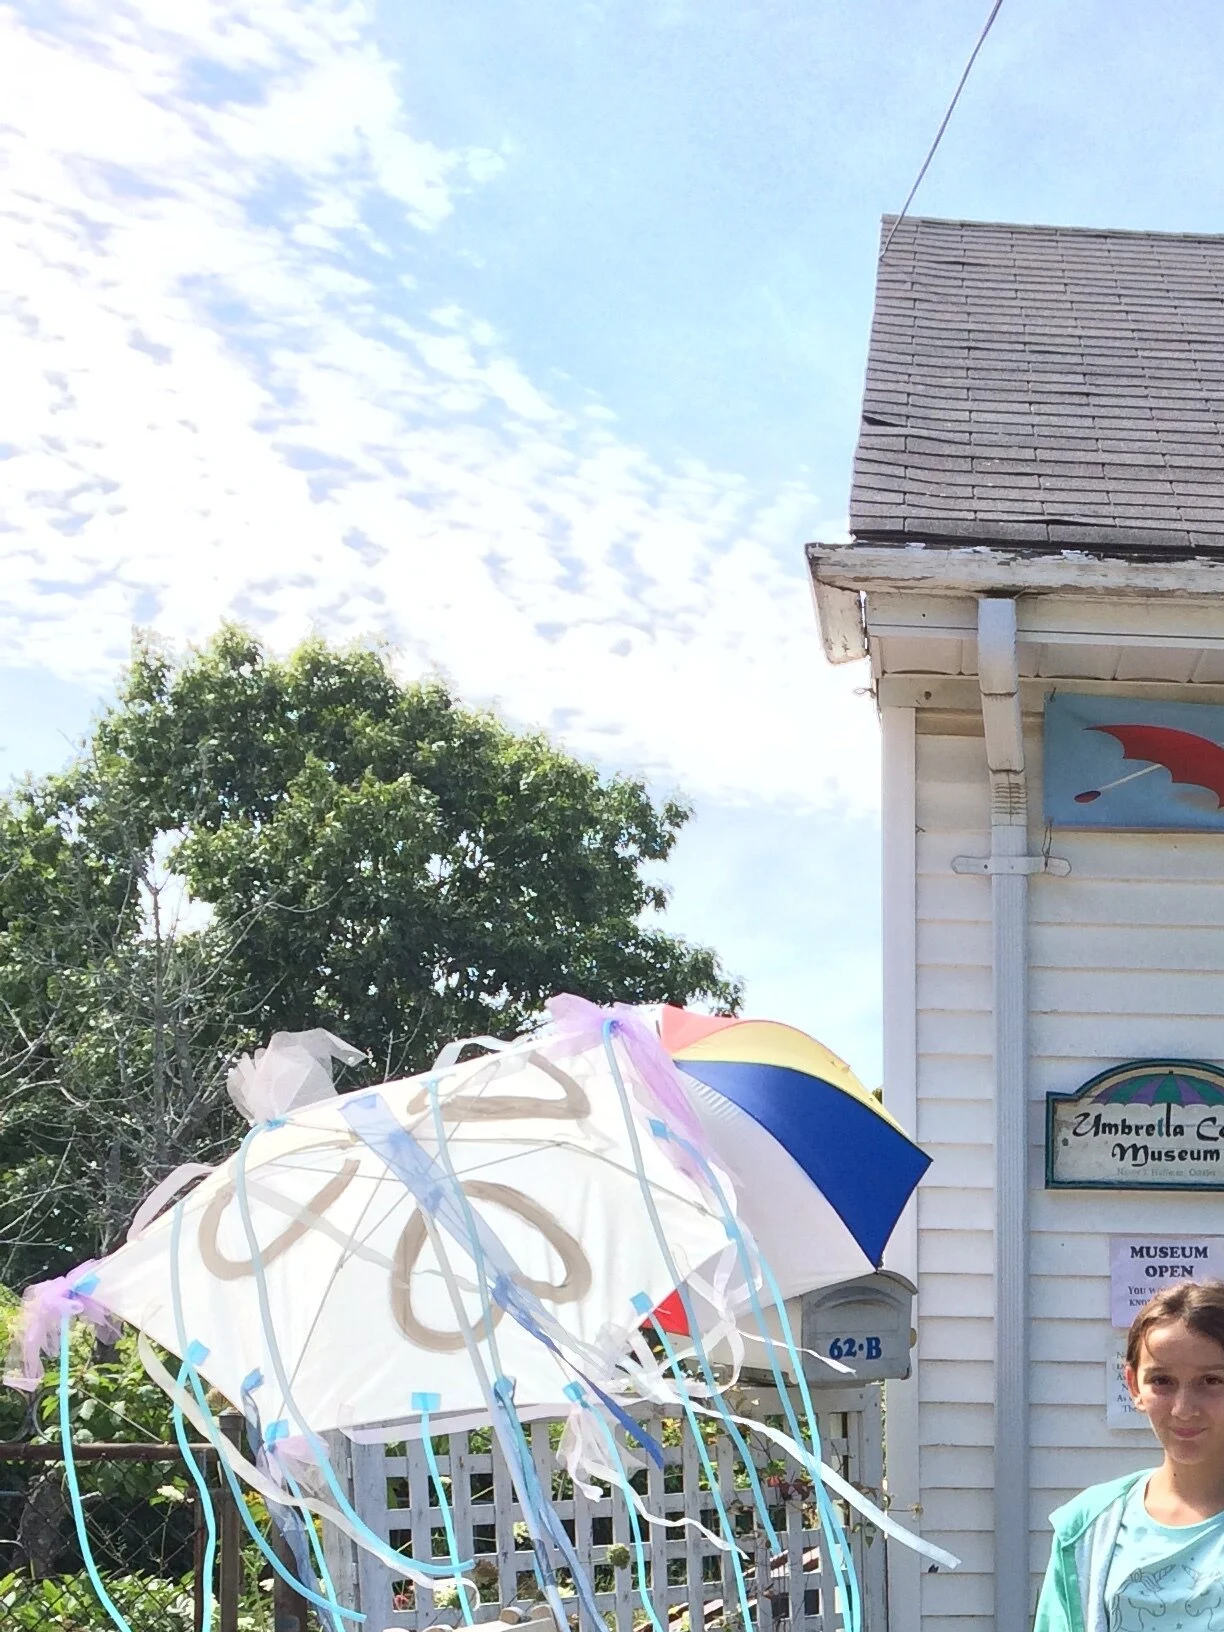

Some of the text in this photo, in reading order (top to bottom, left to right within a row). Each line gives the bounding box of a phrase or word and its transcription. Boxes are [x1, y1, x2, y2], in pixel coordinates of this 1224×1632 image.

[1072, 1103, 1185, 1139] Umbrella
[1111, 1143, 1221, 1167] Museum
[1130, 1246, 1209, 1259] MUSEUM
[1145, 1265, 1194, 1278] OPEN
